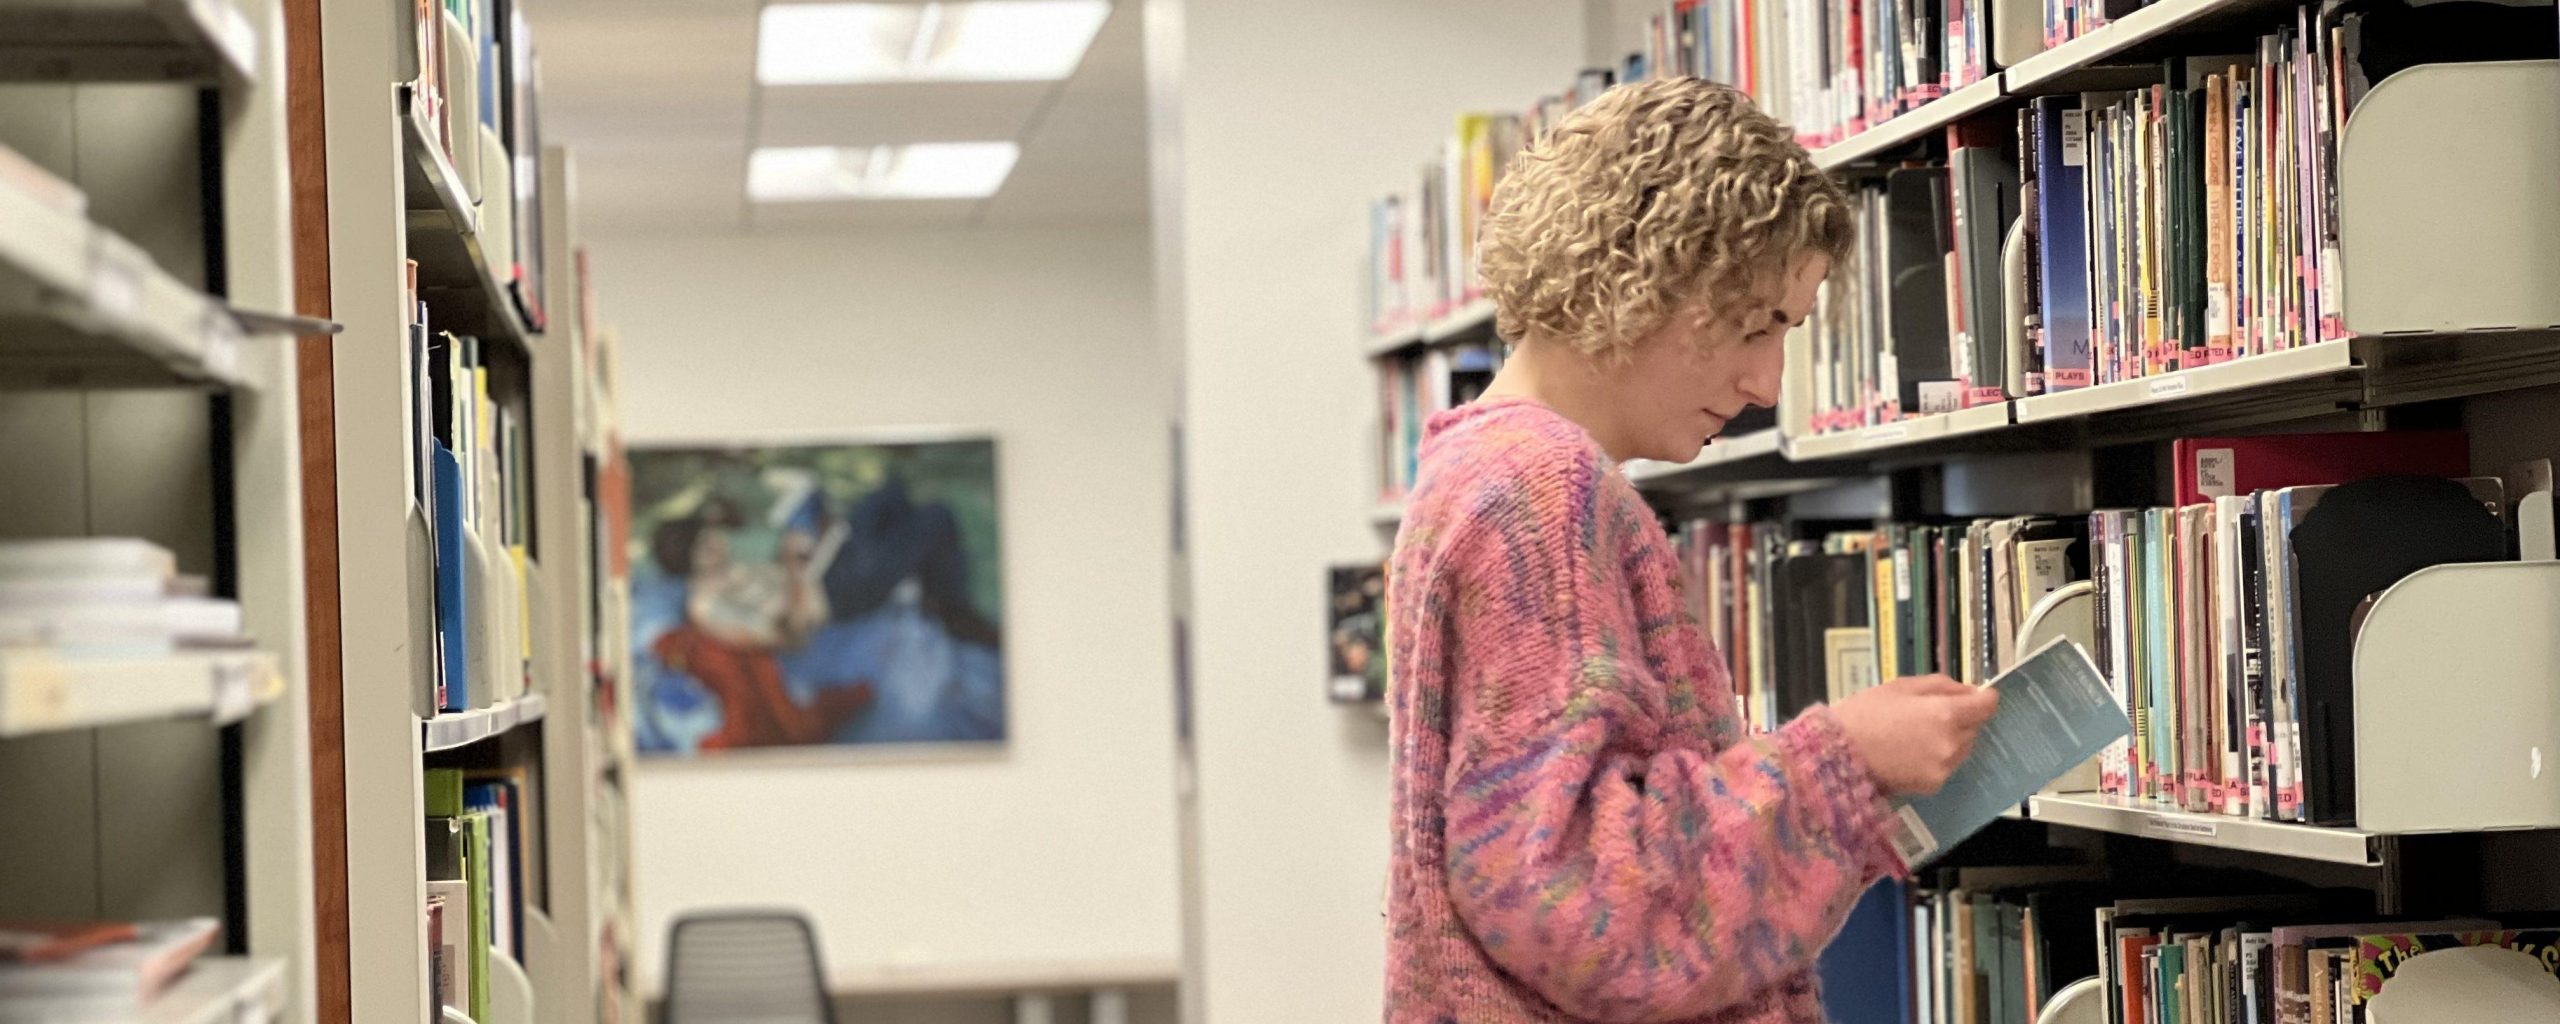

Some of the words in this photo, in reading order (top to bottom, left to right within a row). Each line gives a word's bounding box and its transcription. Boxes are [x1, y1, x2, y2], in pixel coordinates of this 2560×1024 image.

[2235, 118, 2243, 159] LOVE
[2055, 371, 2085, 380] PLAYS
[2378, 942, 2421, 973] The
